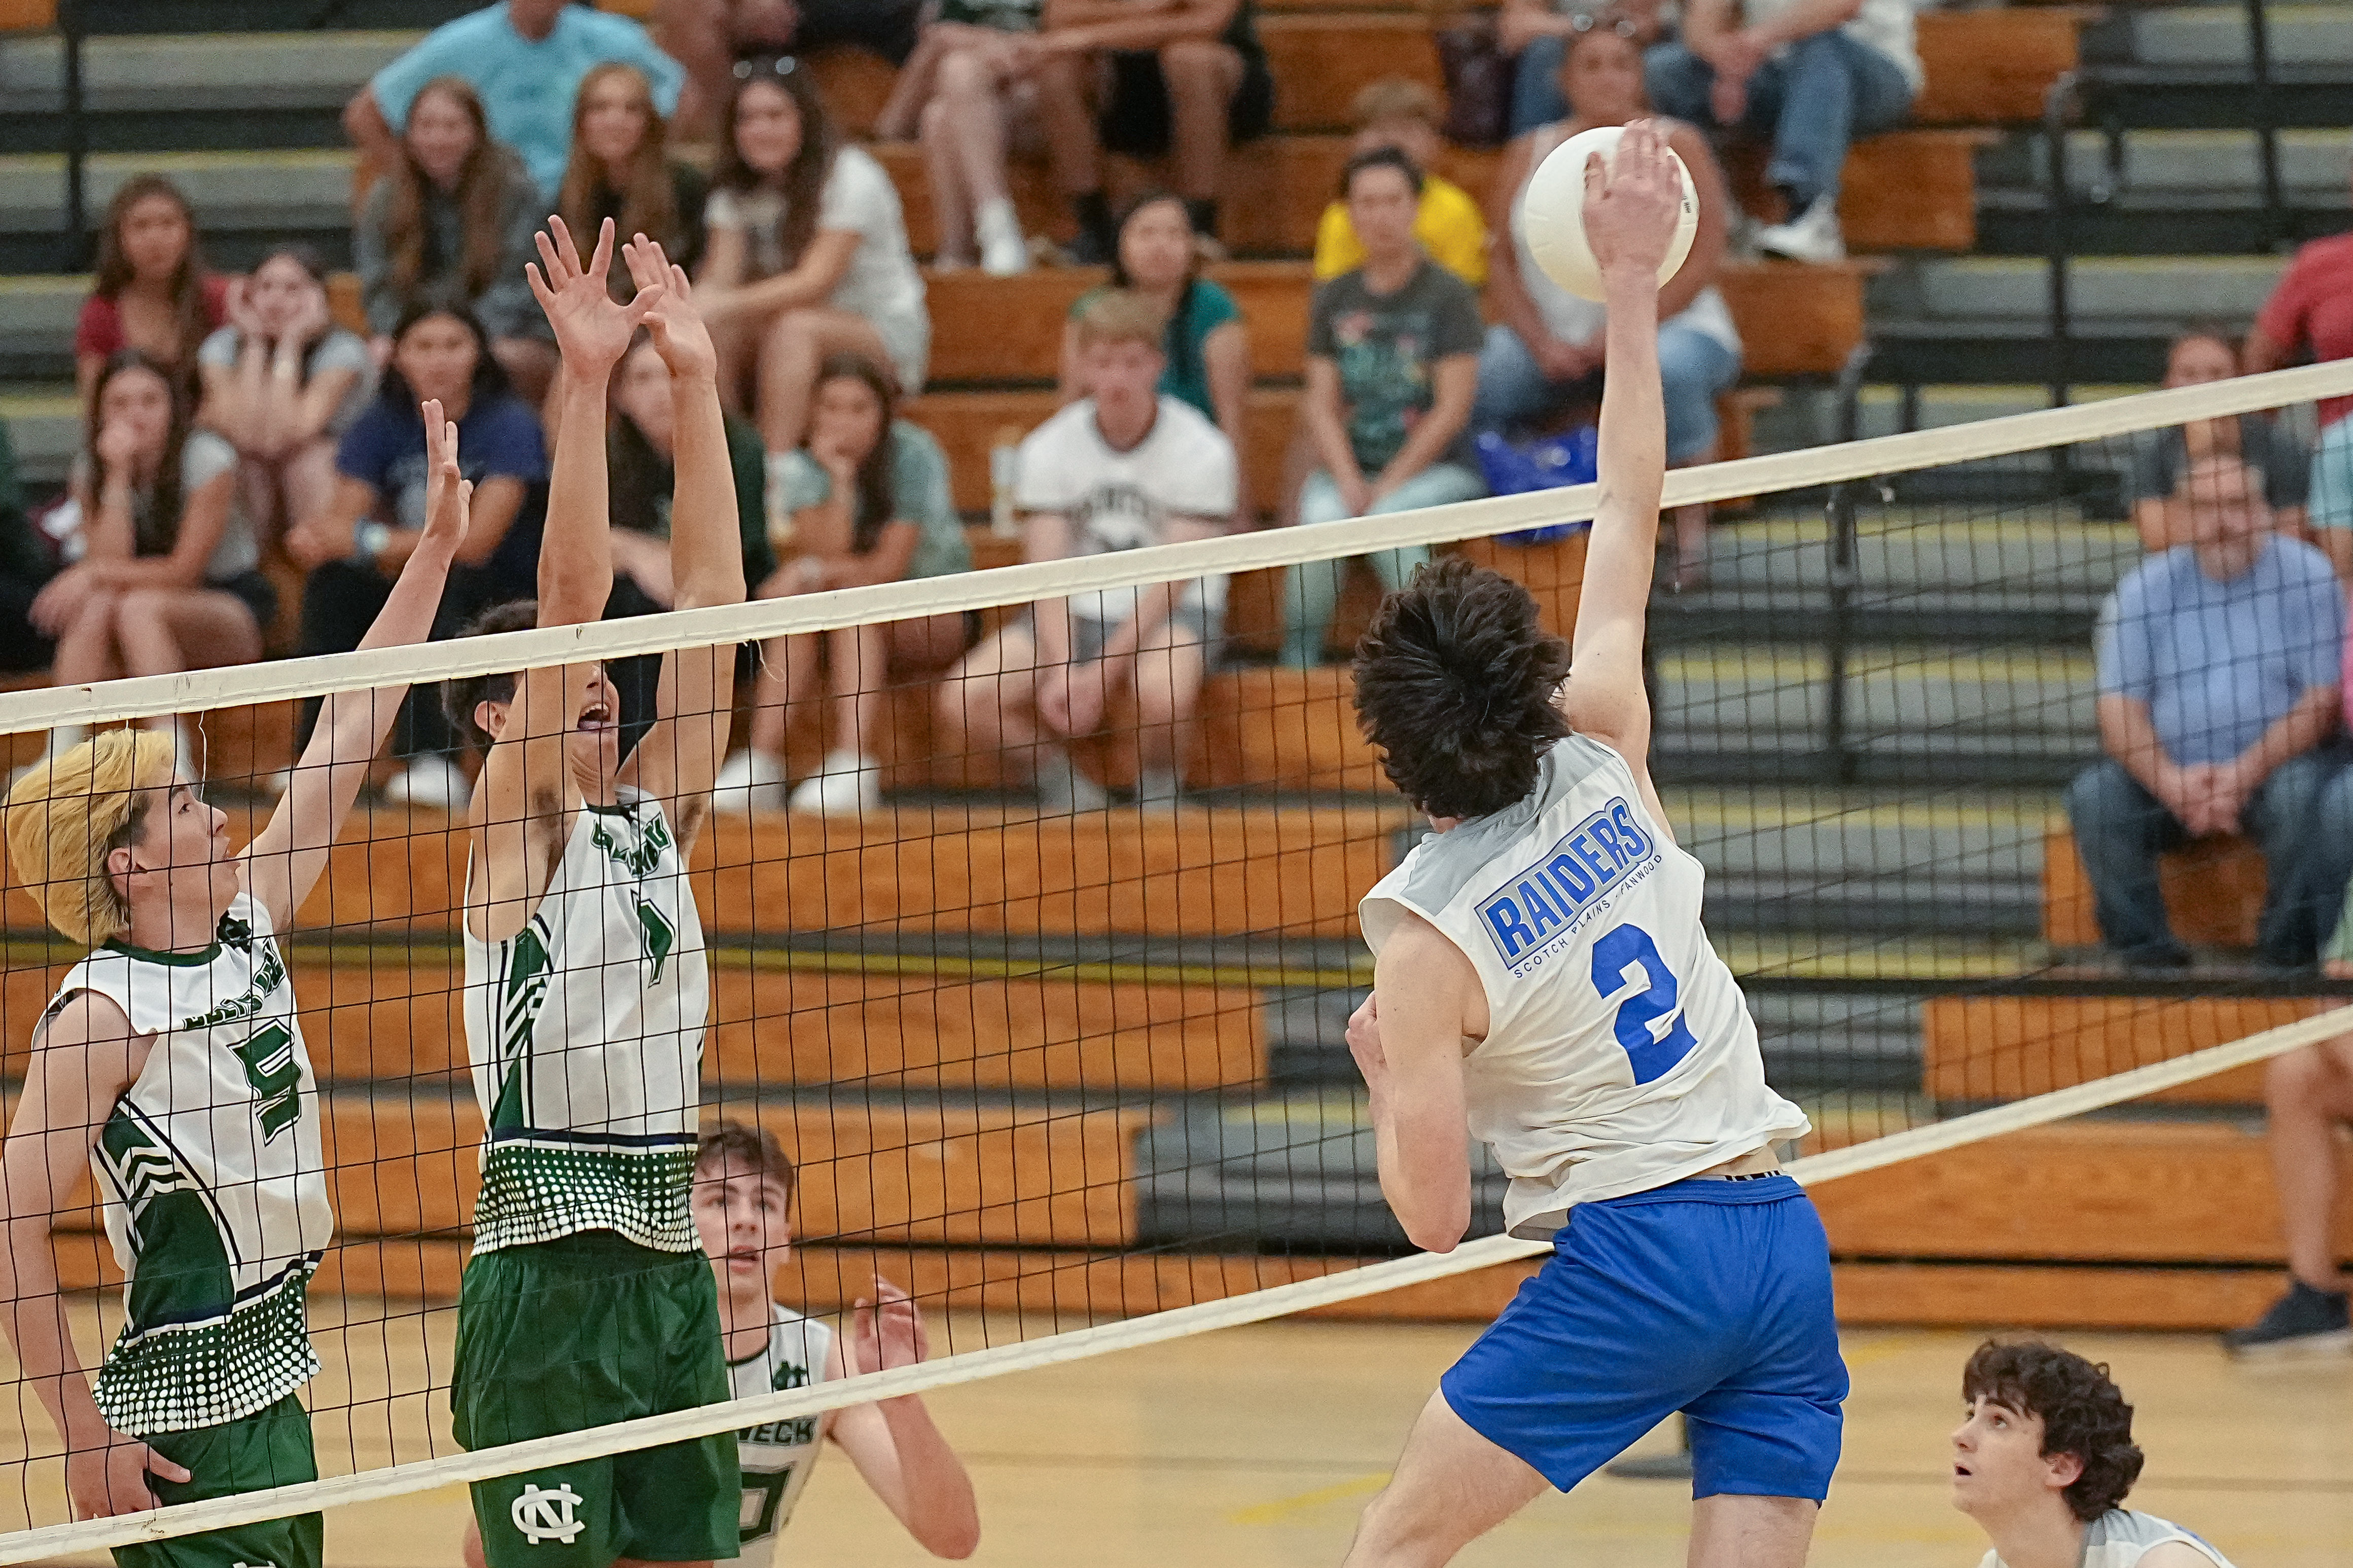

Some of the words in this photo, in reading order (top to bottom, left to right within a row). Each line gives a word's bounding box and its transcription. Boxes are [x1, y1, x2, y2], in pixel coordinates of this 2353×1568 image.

[1483, 803, 1647, 959] RAIDERS
[1514, 938, 1568, 978] SCOTCH
[1571, 899, 1611, 934] PLAINS
[1620, 855, 1662, 895] FANWOOD
[1591, 923, 1698, 1086] 2
